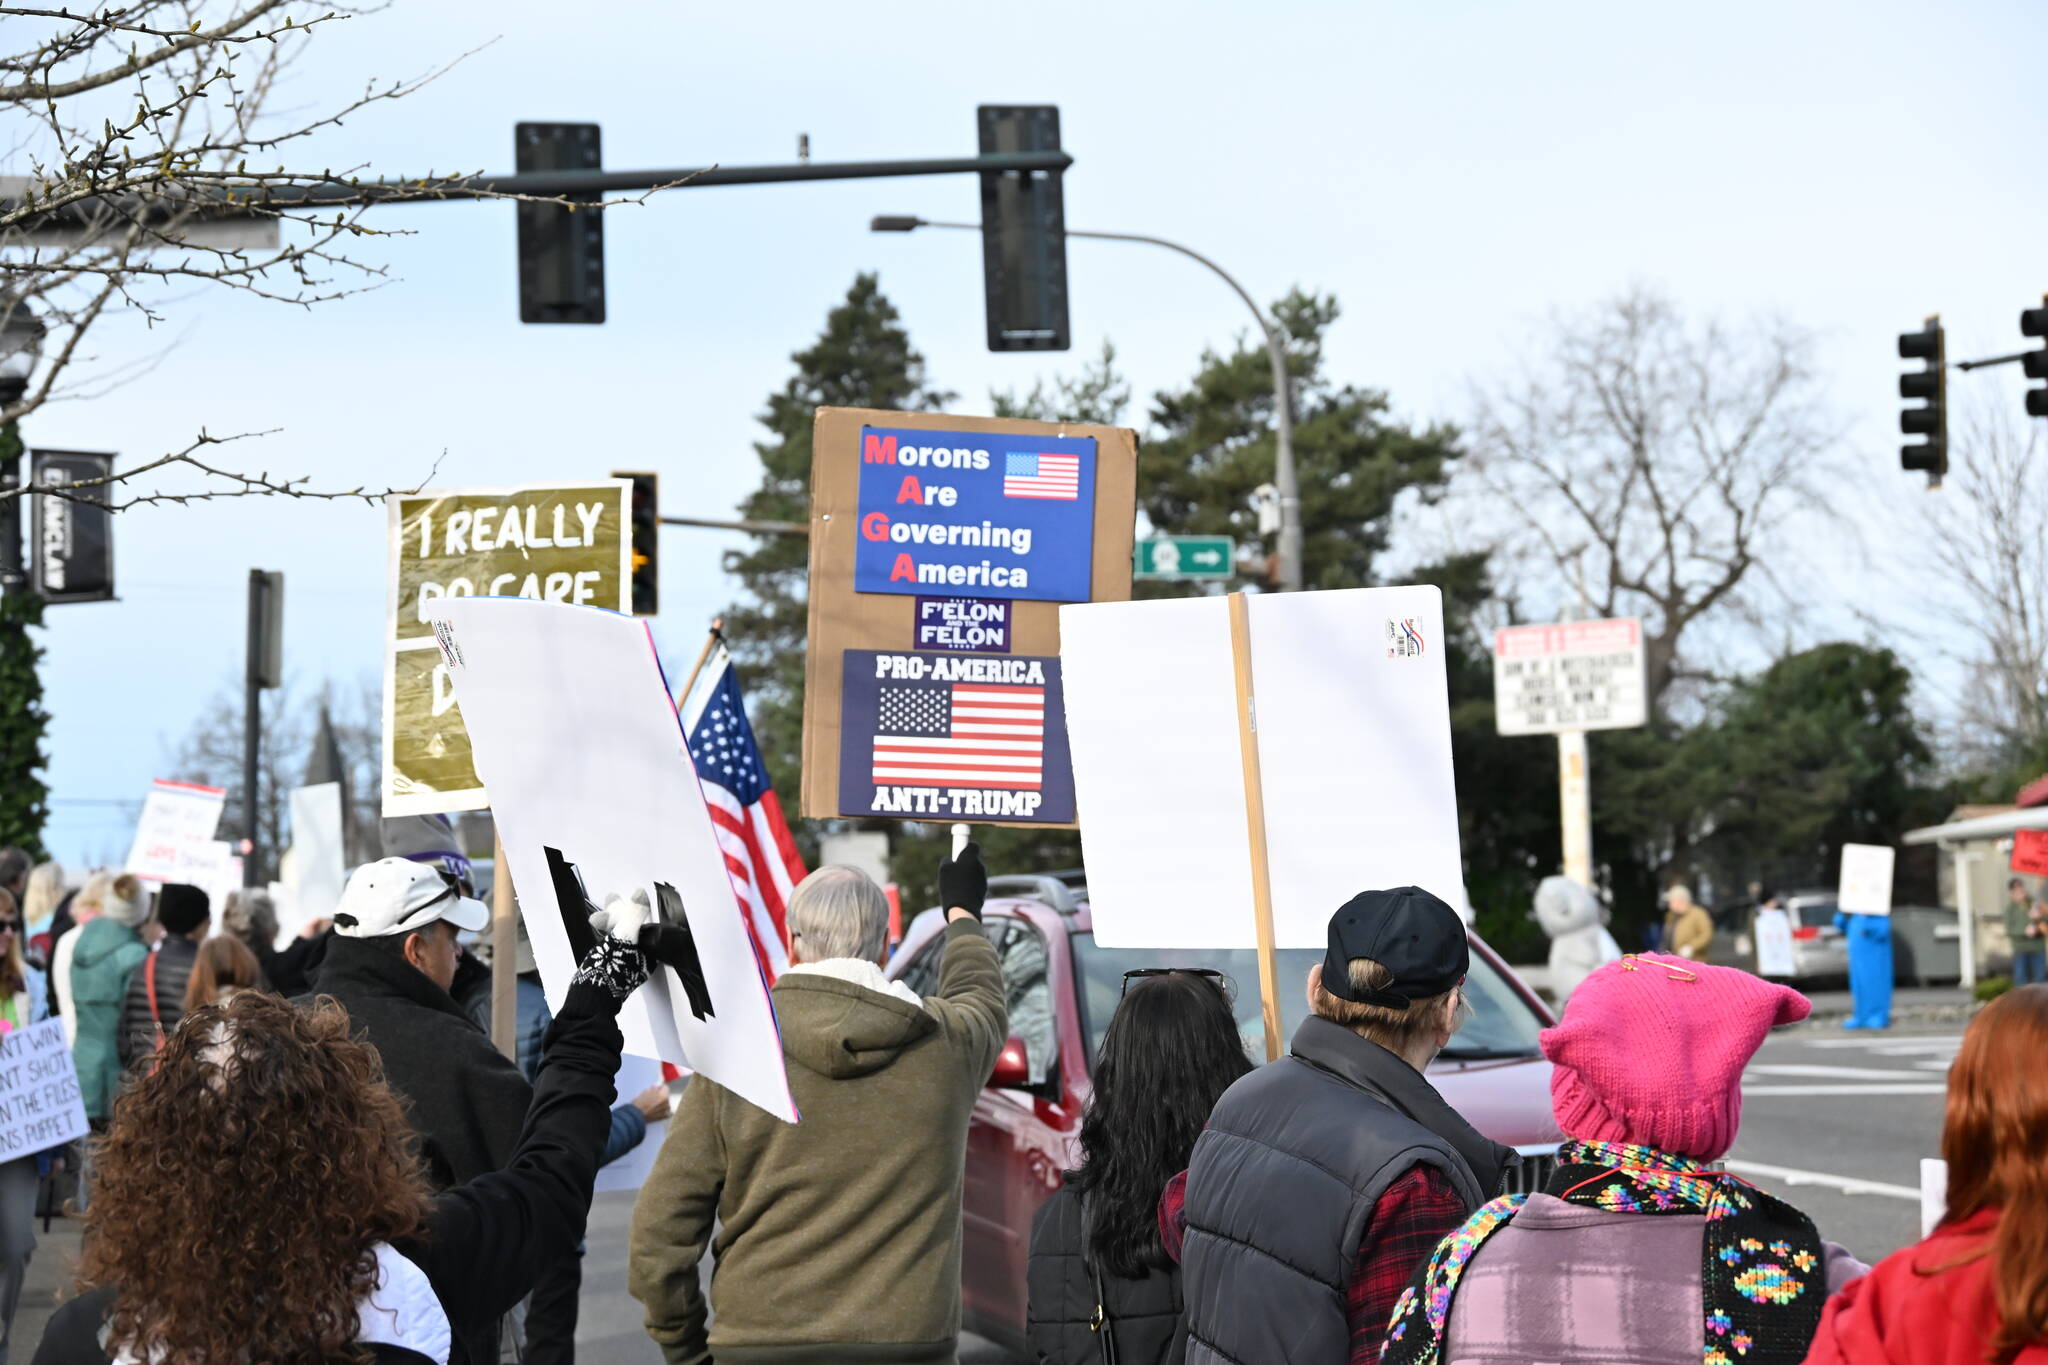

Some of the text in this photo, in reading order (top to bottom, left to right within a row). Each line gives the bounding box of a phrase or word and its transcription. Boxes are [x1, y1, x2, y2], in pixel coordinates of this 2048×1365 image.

[864, 435, 990, 470] Morons
[896, 475, 958, 507] Are
[419, 502, 604, 558] I REALLY
[861, 511, 1032, 555] Governing
[889, 553, 1028, 588] America
[921, 625, 1004, 646] FELON
[875, 655, 1045, 684] PRO-AMERICA
[871, 786, 1042, 816] ANTI-TRUMP
[26, 1024, 61, 1051] WIN
[28, 1051, 68, 1082] SHOT
[11, 1089, 43, 1117] THE
[44, 1076, 80, 1109] FILES
